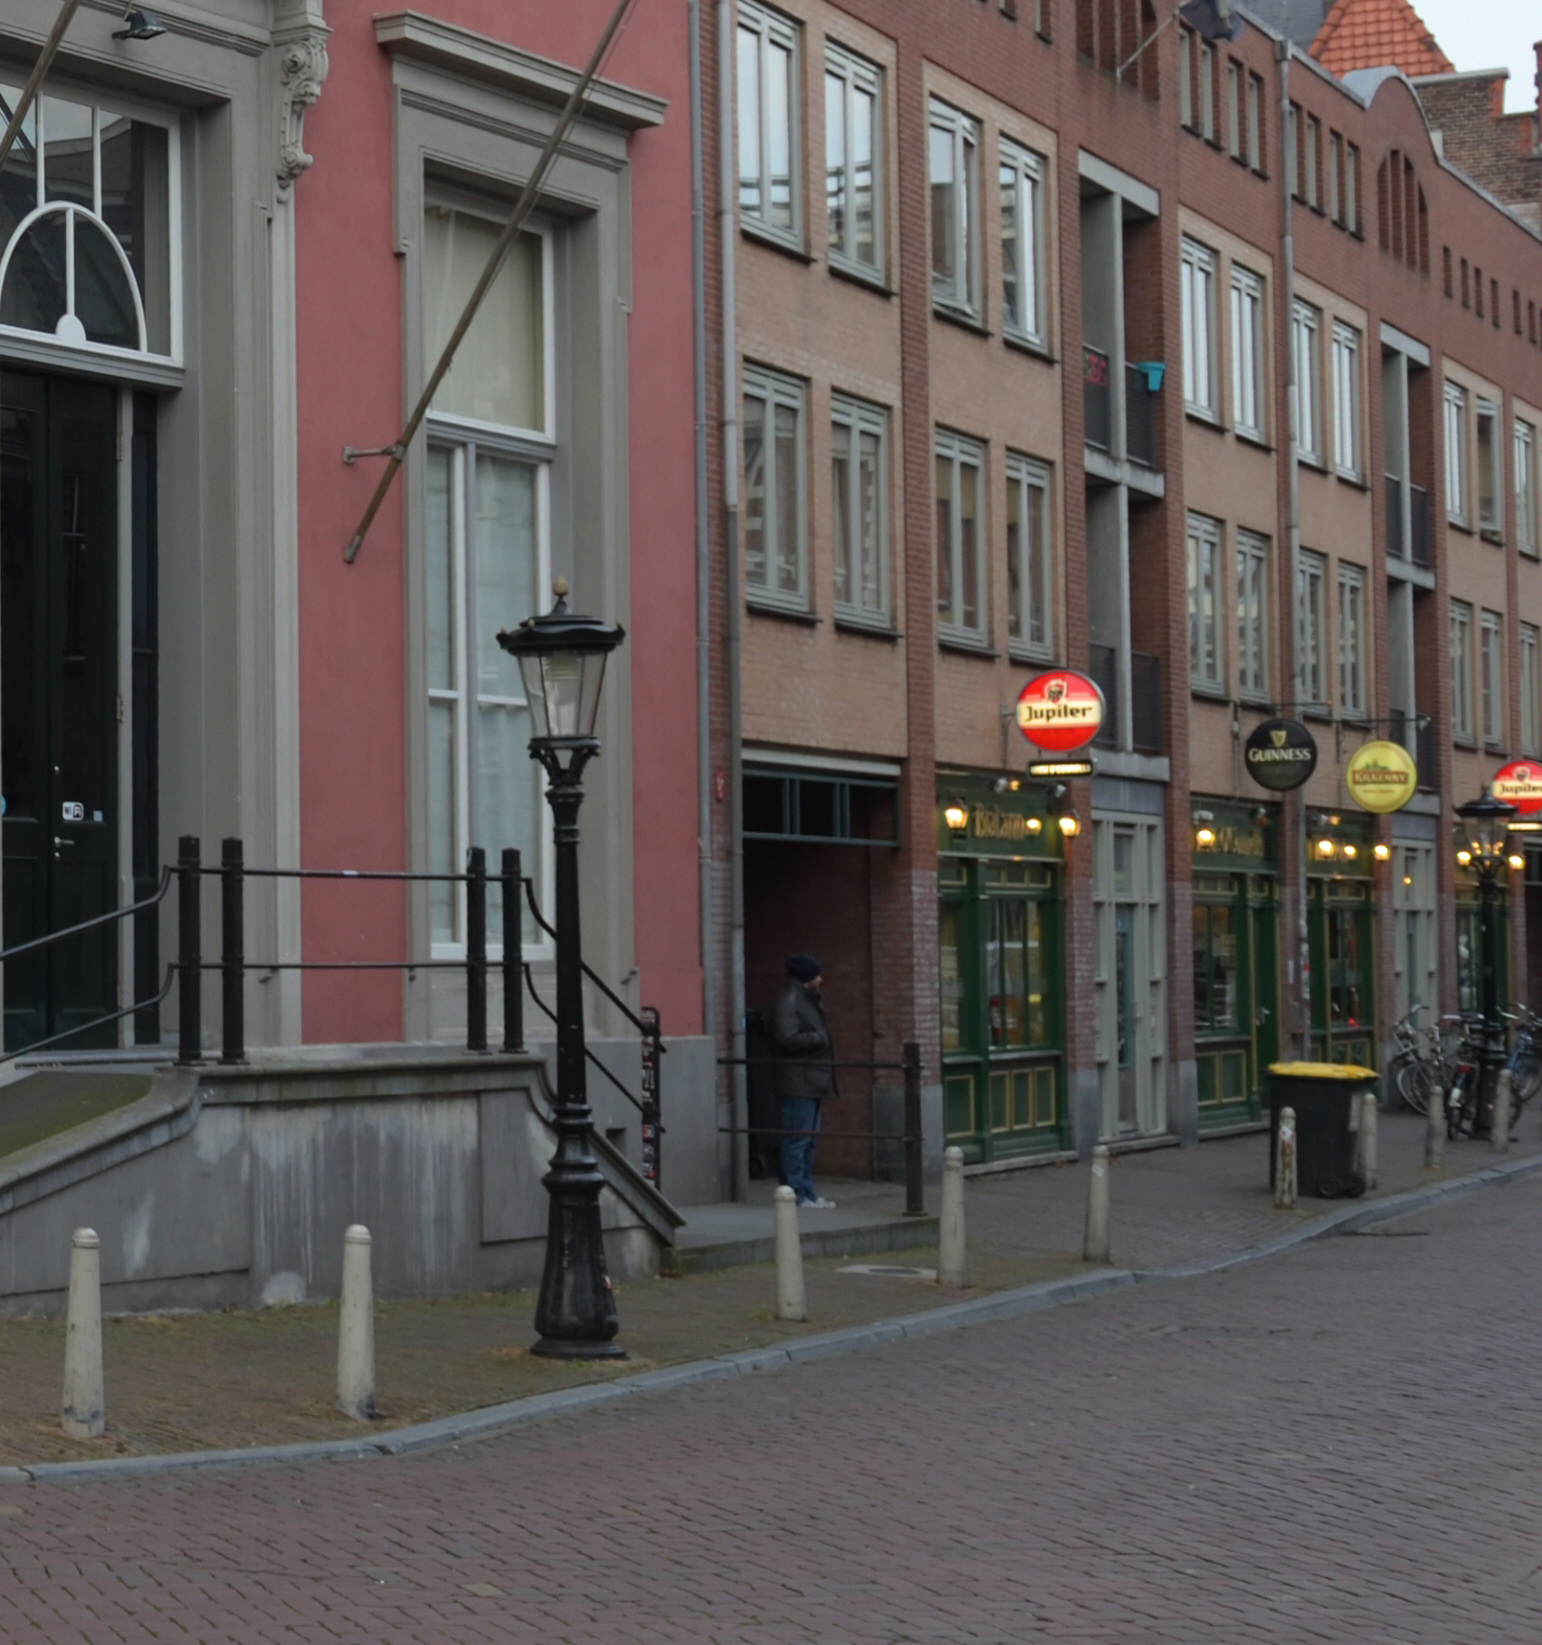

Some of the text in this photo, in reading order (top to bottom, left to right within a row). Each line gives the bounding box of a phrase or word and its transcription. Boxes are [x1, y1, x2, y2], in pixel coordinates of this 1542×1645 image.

[1024, 703, 1093, 722] Jupiler
[1248, 747, 1312, 763] GUINNESS
[1354, 770, 1407, 782] KILKENNY
[1500, 783, 1542, 794] Jupile
